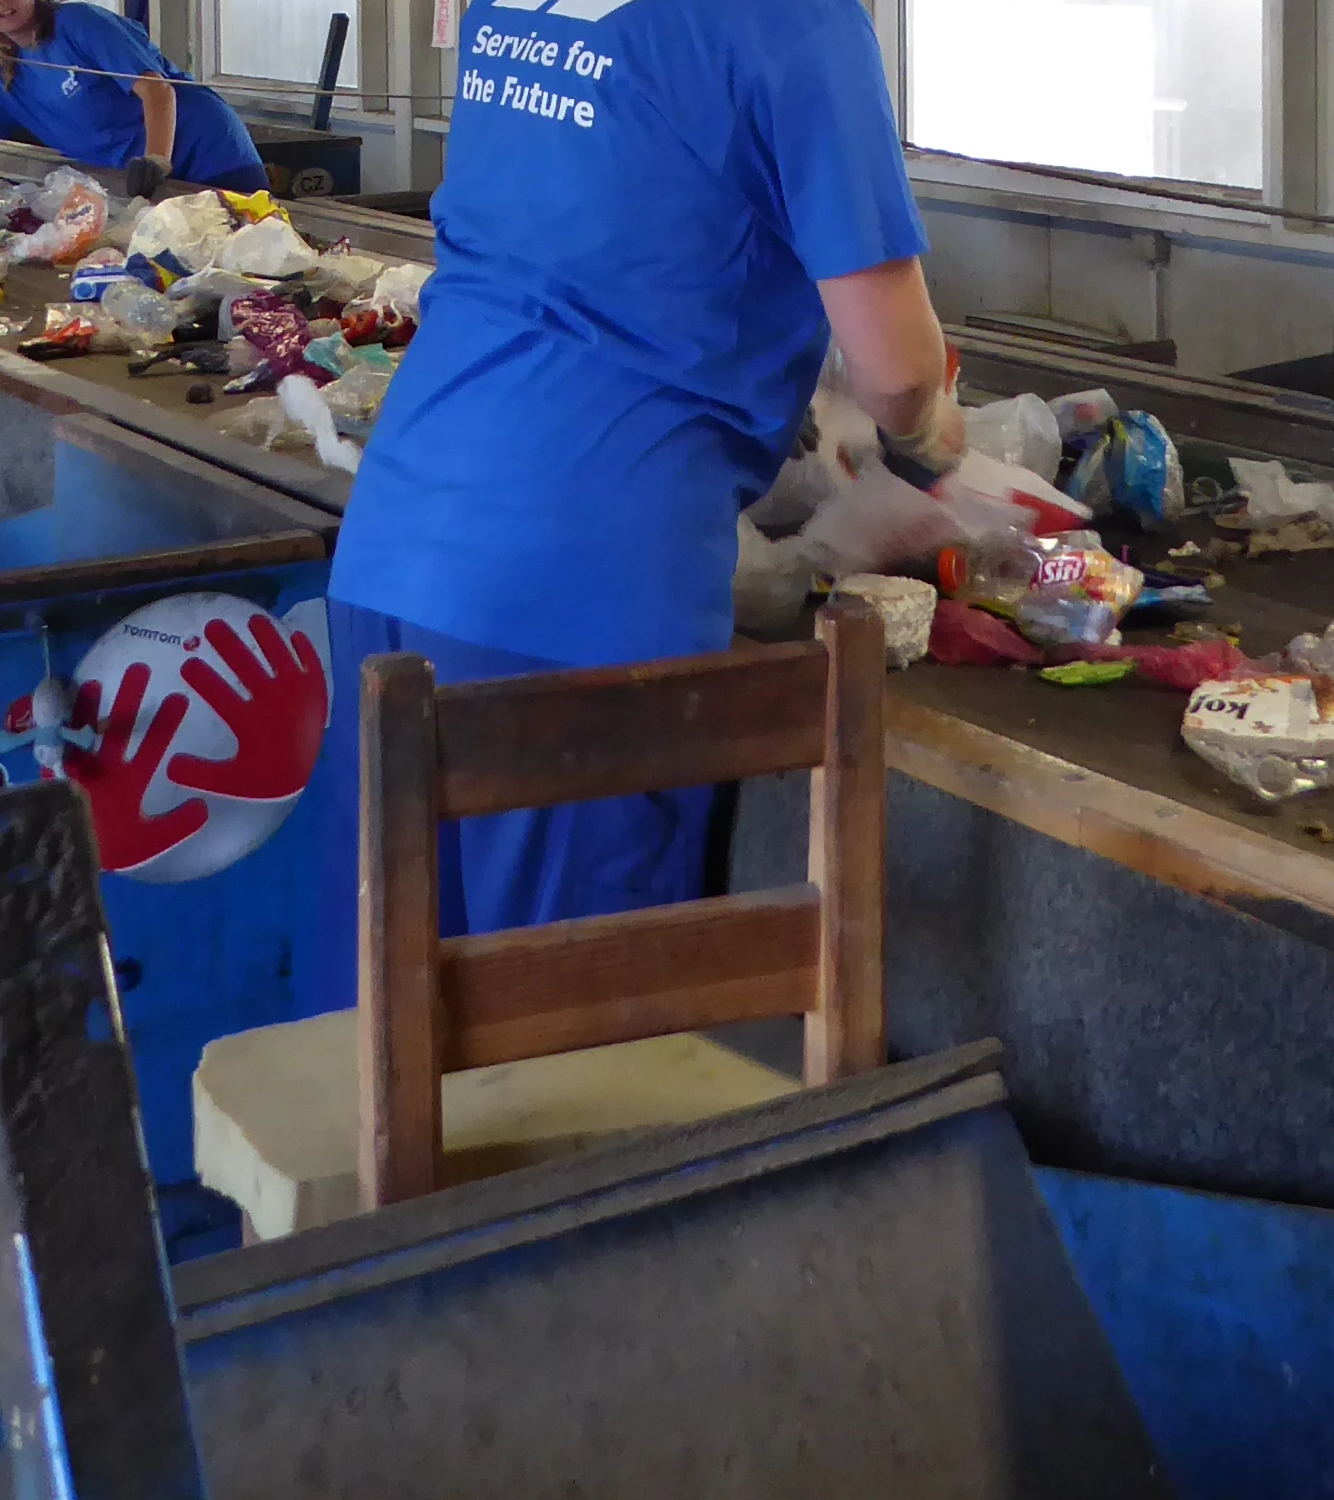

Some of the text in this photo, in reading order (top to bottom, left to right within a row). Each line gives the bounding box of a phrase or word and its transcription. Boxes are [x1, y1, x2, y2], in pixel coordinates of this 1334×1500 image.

[471, 24, 613, 81] Service for
[462, 69, 595, 128] the Future
